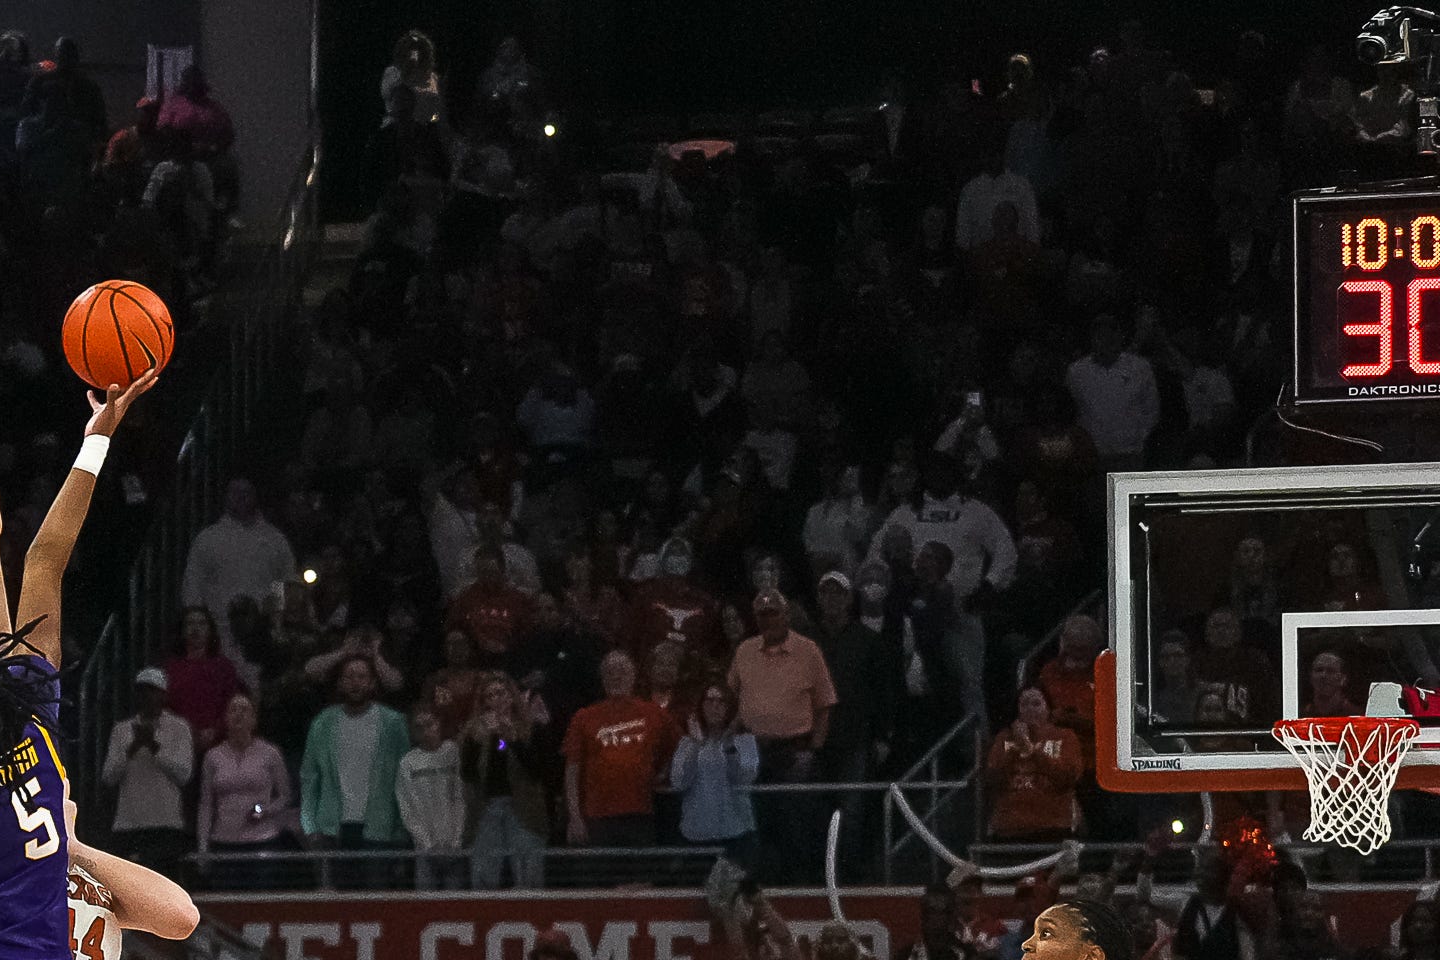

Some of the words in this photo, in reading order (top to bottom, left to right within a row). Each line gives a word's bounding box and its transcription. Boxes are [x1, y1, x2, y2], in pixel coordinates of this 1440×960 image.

[1342, 278, 1440, 376] 30
[1348, 384, 1440, 396] DAKTRONIC
[1131, 758, 1181, 770] SPALDING
[11, 776, 60, 860] 5
